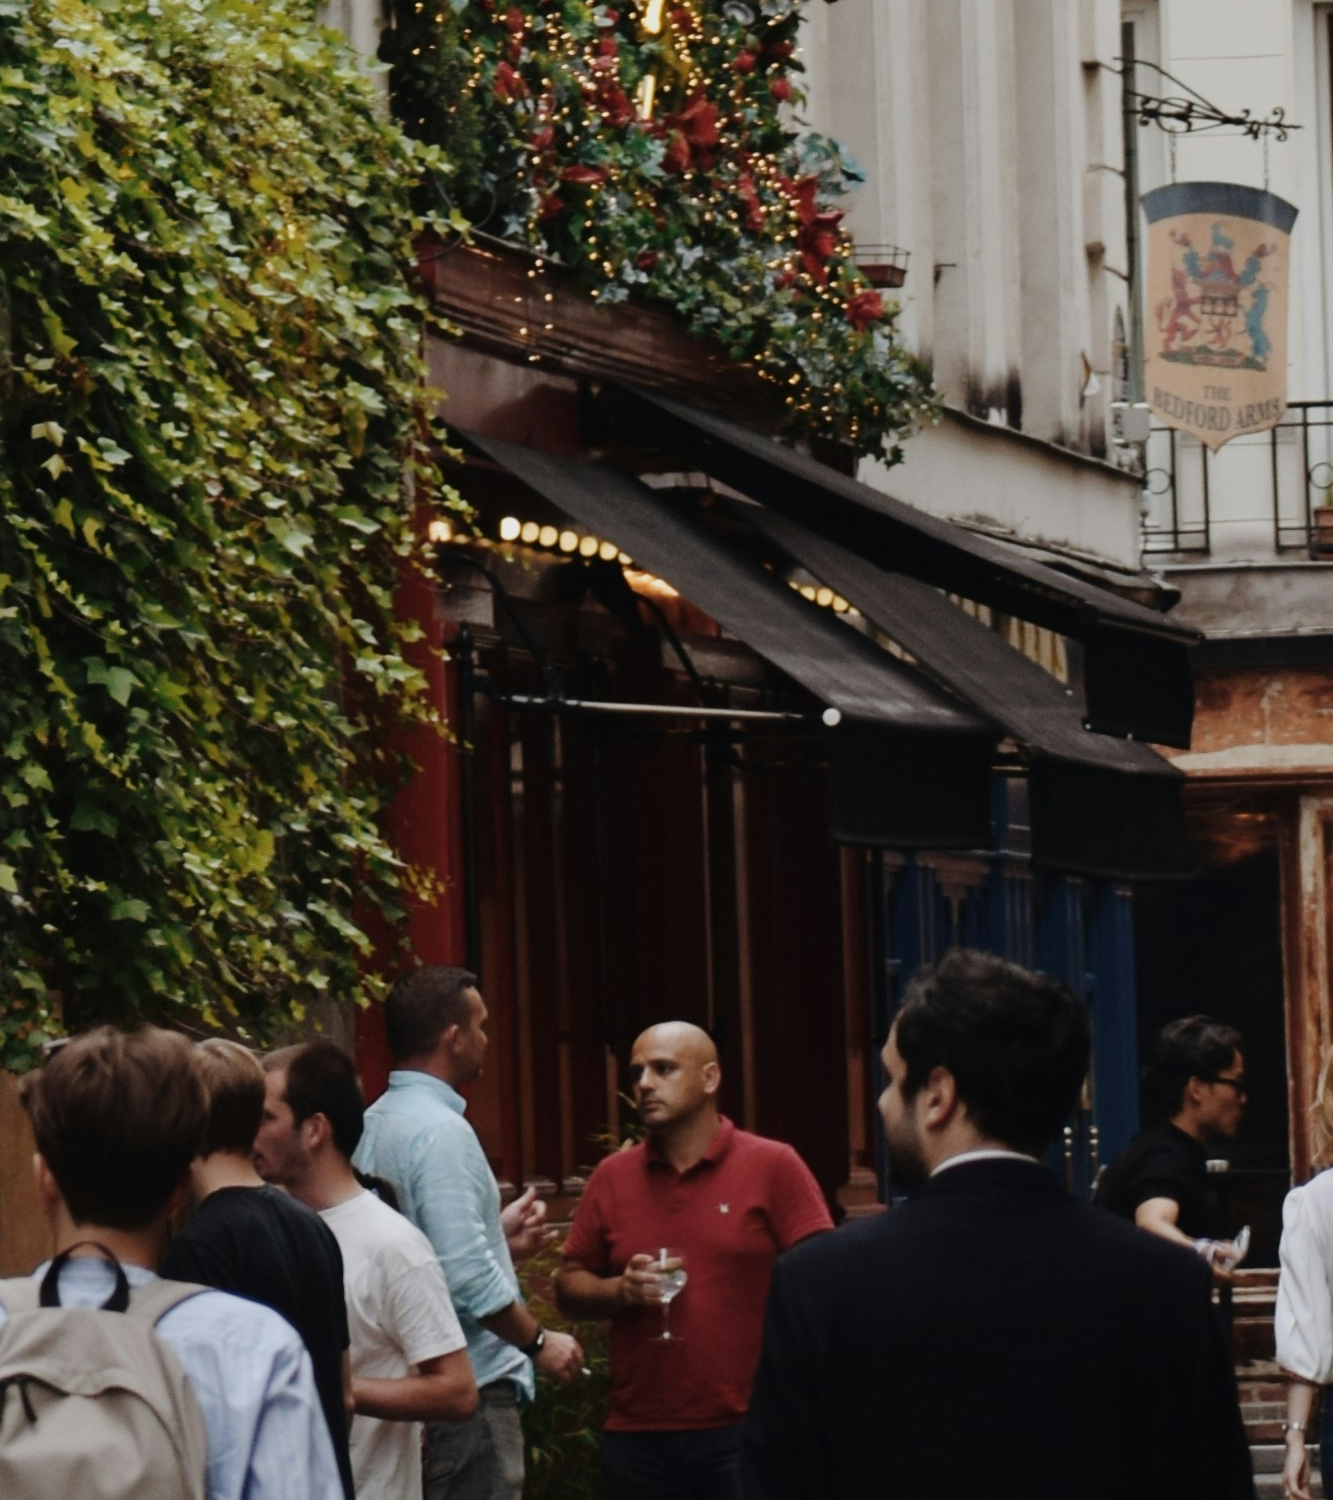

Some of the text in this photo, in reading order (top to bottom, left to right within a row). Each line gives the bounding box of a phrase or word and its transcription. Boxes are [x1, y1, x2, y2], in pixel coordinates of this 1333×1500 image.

[1203, 386, 1231, 400] THE
[1153, 386, 1281, 431] BEDFORD ARMS
